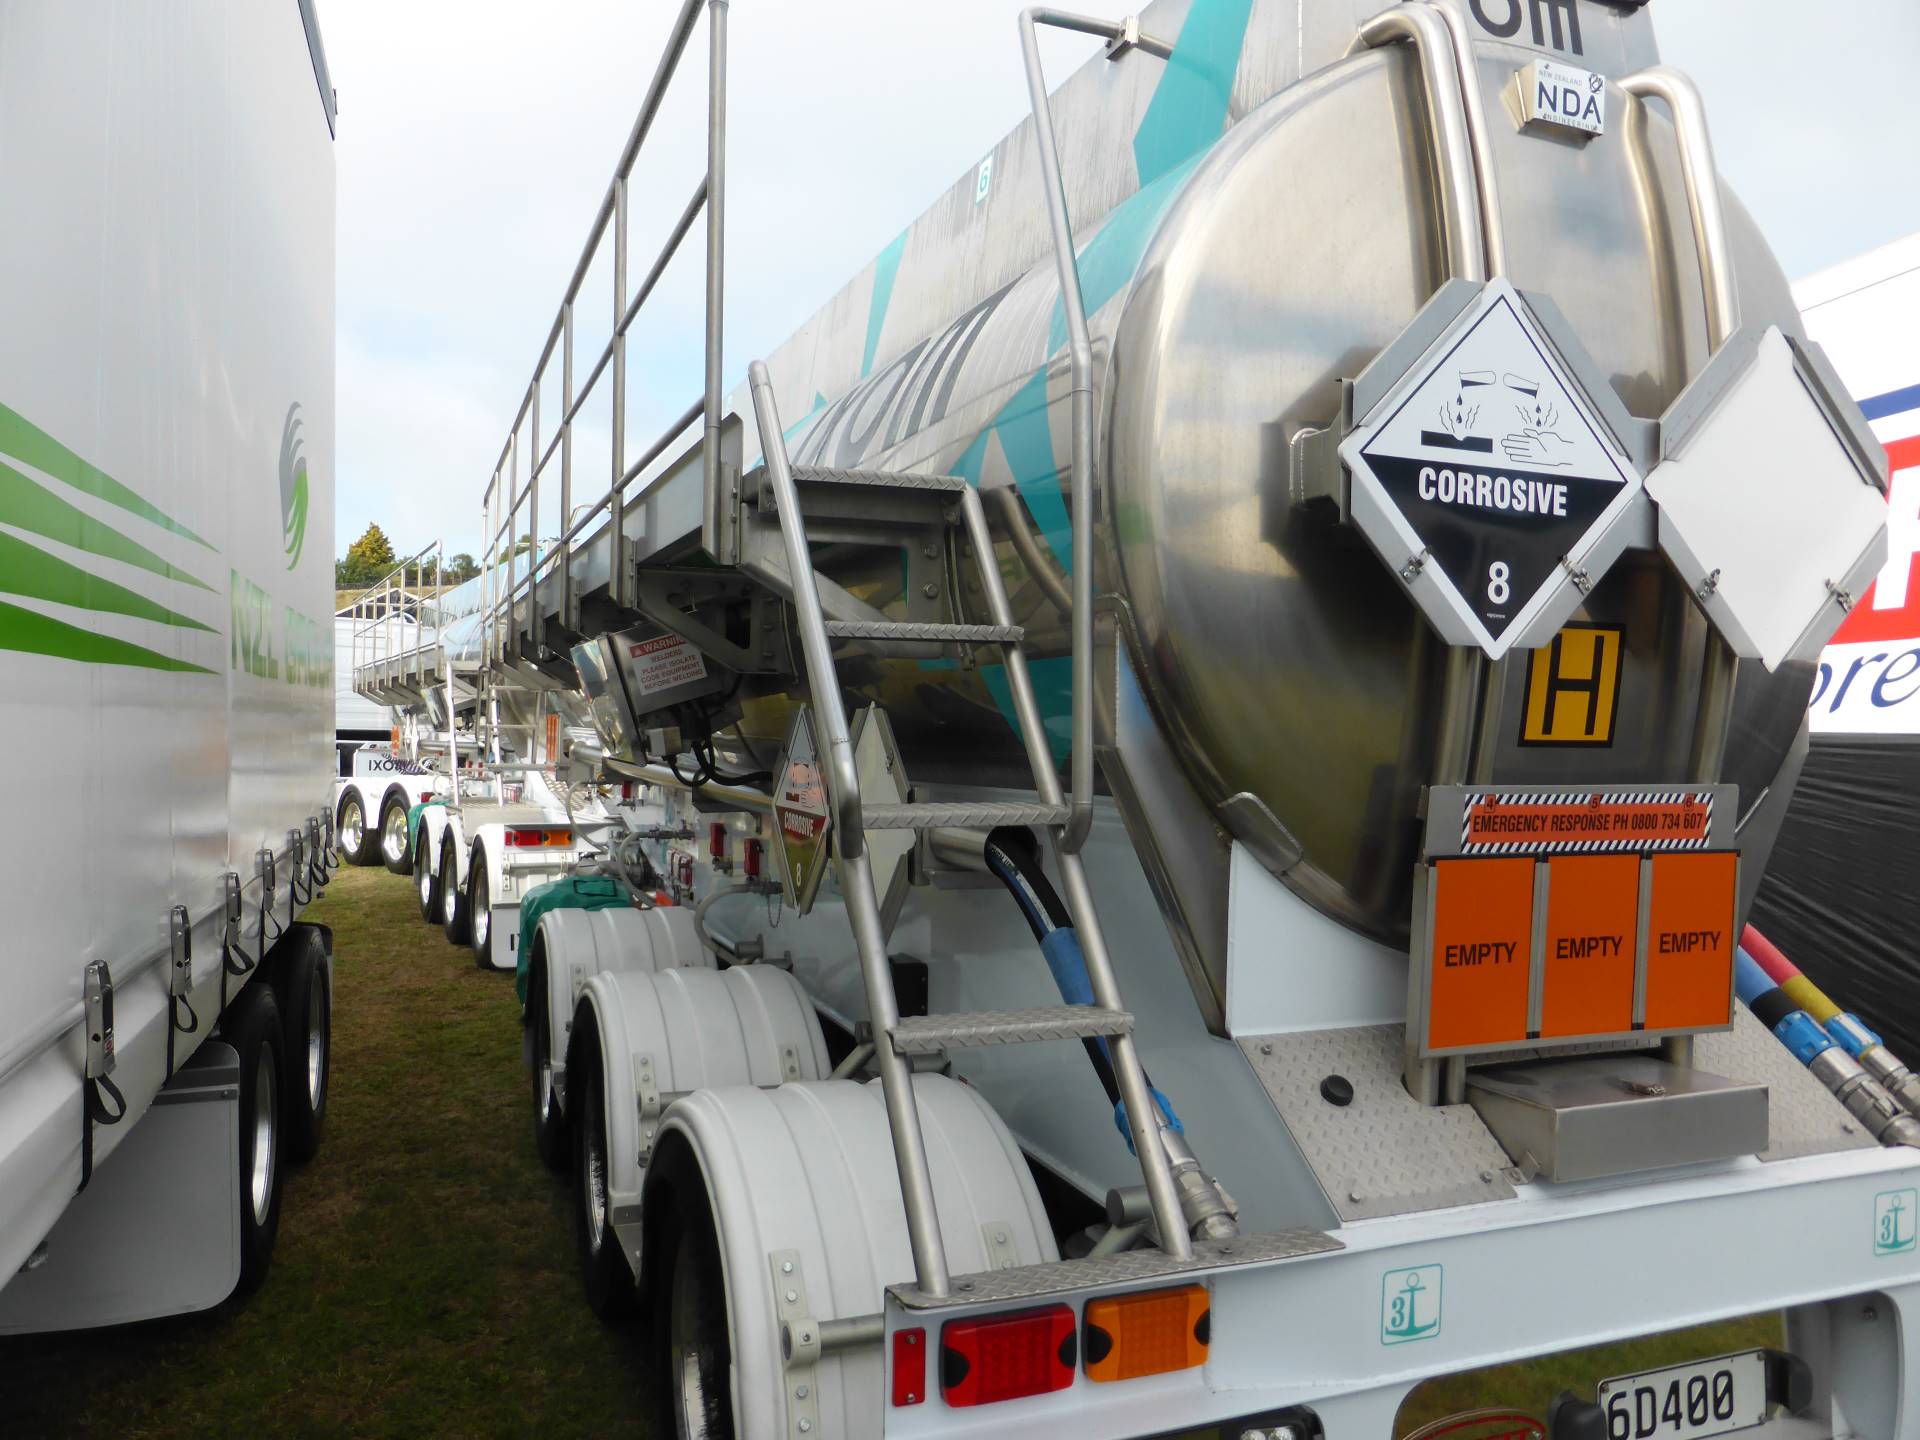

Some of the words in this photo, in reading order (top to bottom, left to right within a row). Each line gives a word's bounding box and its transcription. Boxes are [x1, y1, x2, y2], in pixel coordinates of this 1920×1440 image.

[1538, 81, 1602, 124] NDA
[979, 165, 990, 193] 6
[1418, 466, 1568, 517] CORROSIVE
[1487, 561, 1510, 605] 8
[1541, 633, 1605, 736] H
[1486, 800, 1495, 810] 4
[1591, 797, 1599, 809] 5
[784, 810, 814, 838] CORROSIVE
[1473, 814, 1549, 833] EMERGENCY
[1550, 813, 1610, 832] RESPONSE
[1613, 813, 1629, 831] PH
[1631, 813, 1658, 831] 0800
[1661, 812, 1681, 830] 734
[1683, 812, 1704, 830] 607
[796, 862, 802, 887] 8
[1445, 942, 1517, 967] EMPTY
[1556, 936, 1623, 960] EMPTY
[1659, 931, 1721, 954] EMPTY
[1608, 1369, 1734, 1440] 6D400
